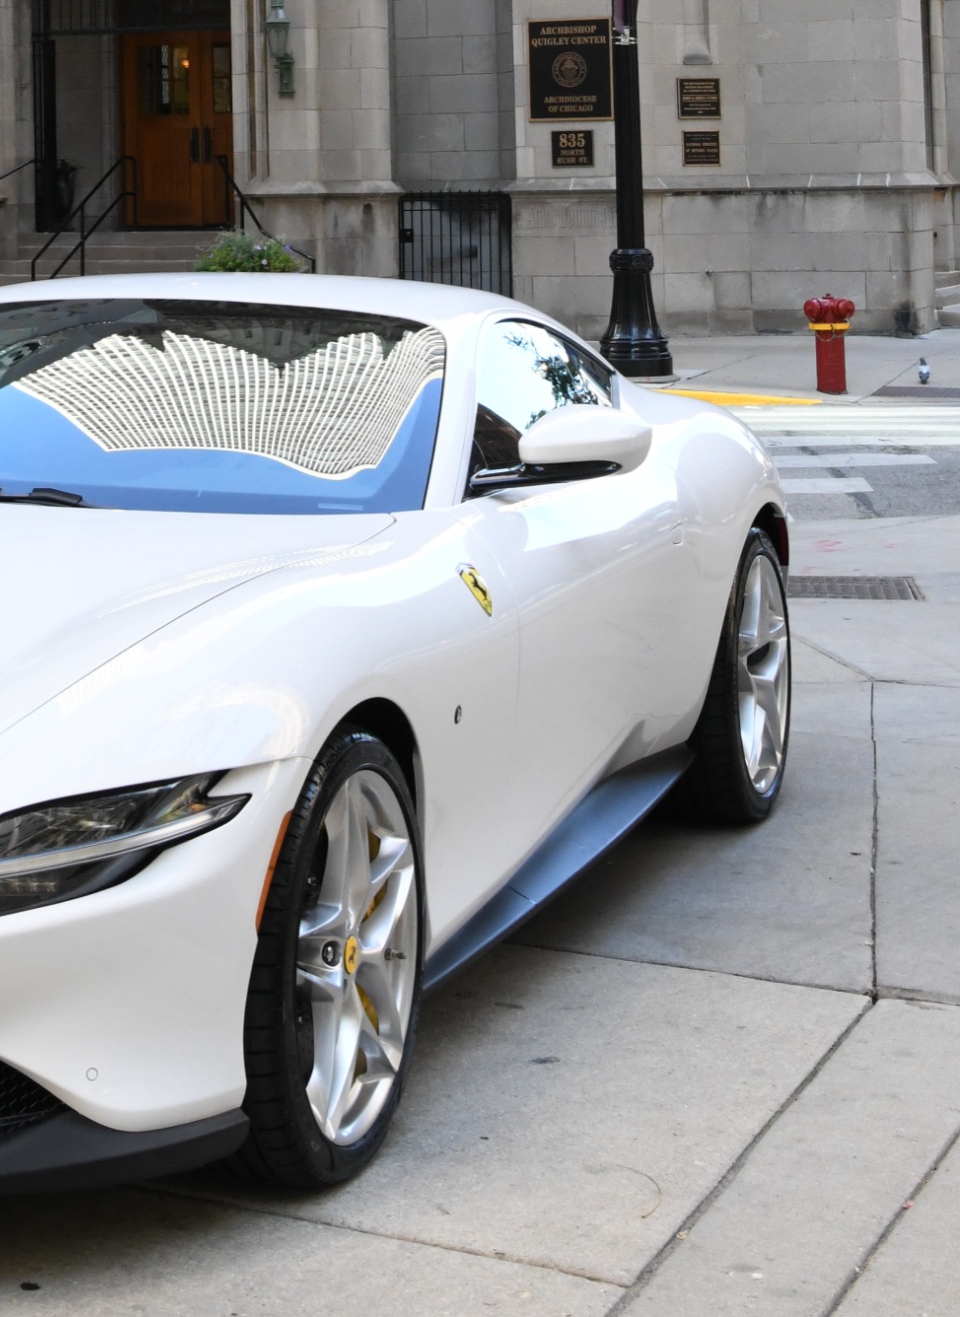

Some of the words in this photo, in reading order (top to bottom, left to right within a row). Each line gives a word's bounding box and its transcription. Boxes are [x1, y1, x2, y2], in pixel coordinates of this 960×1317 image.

[540, 25, 597, 35] ARCHBISHOP
[531, 37, 570, 47] QUIGLEY
[570, 35, 606, 45] CENTER
[543, 95, 597, 104] ARCHDIOCESE
[547, 105, 558, 113] OF
[559, 104, 593, 113] CHICAGO
[559, 133, 586, 148] 835
[556, 156, 577, 164] RUSH
